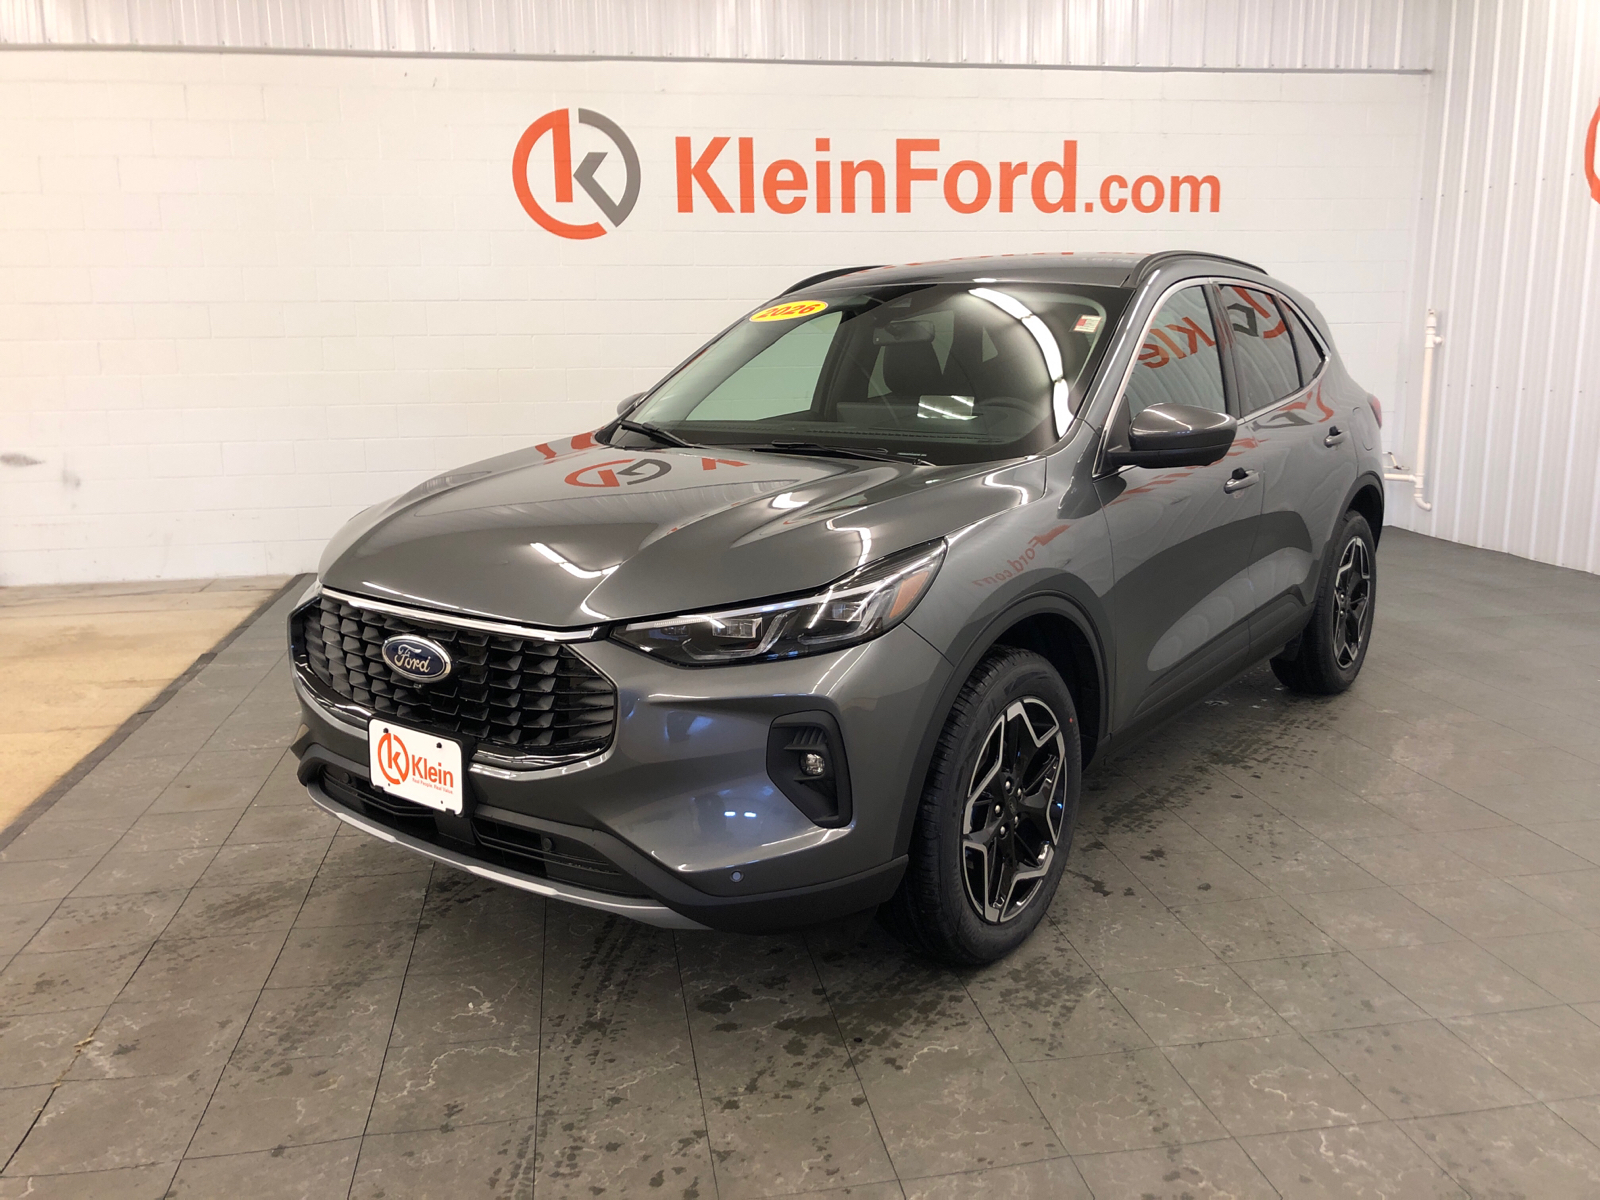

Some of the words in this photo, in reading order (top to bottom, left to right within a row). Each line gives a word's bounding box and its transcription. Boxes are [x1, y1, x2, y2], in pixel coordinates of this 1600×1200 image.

[675, 136, 1221, 215] KleinFord.com
[757, 303, 821, 319] 2026
[394, 643, 431, 673] Ford
[411, 754, 454, 789] Klein
